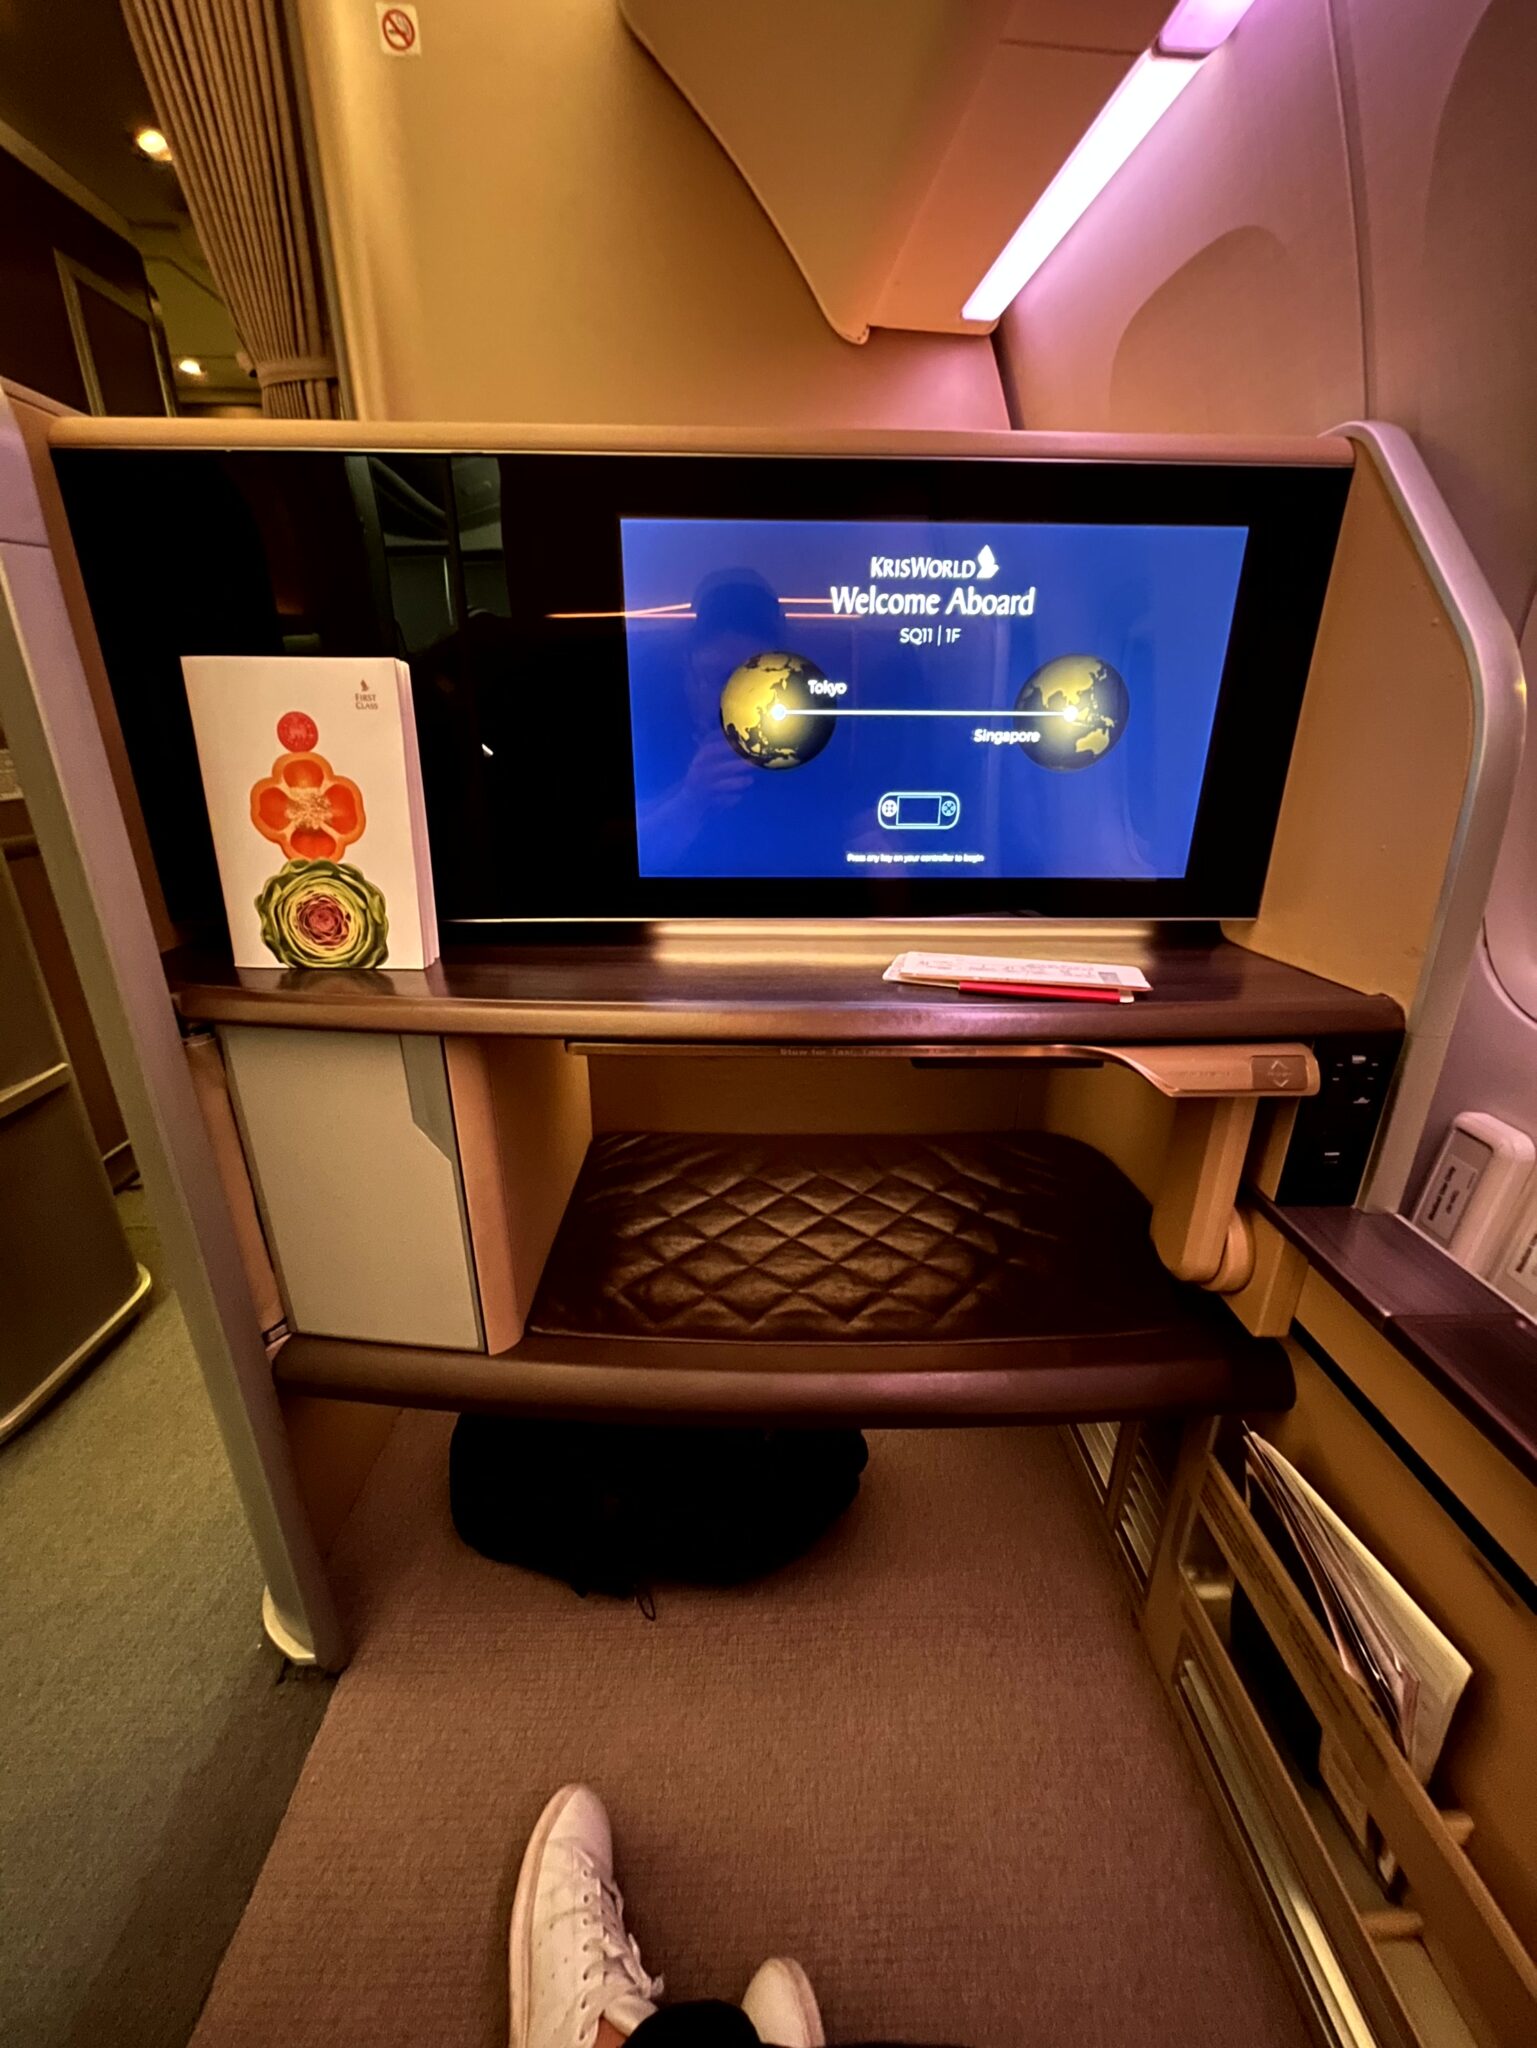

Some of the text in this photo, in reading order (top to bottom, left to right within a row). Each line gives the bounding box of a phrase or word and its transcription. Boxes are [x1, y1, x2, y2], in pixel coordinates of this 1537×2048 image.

[830, 585, 1036, 616] Welcome Aboard
[899, 627, 933, 645] SQ11
[945, 627, 962, 643] 1F
[808, 680, 848, 697] Tokyo
[973, 729, 1041, 744] Singapore
